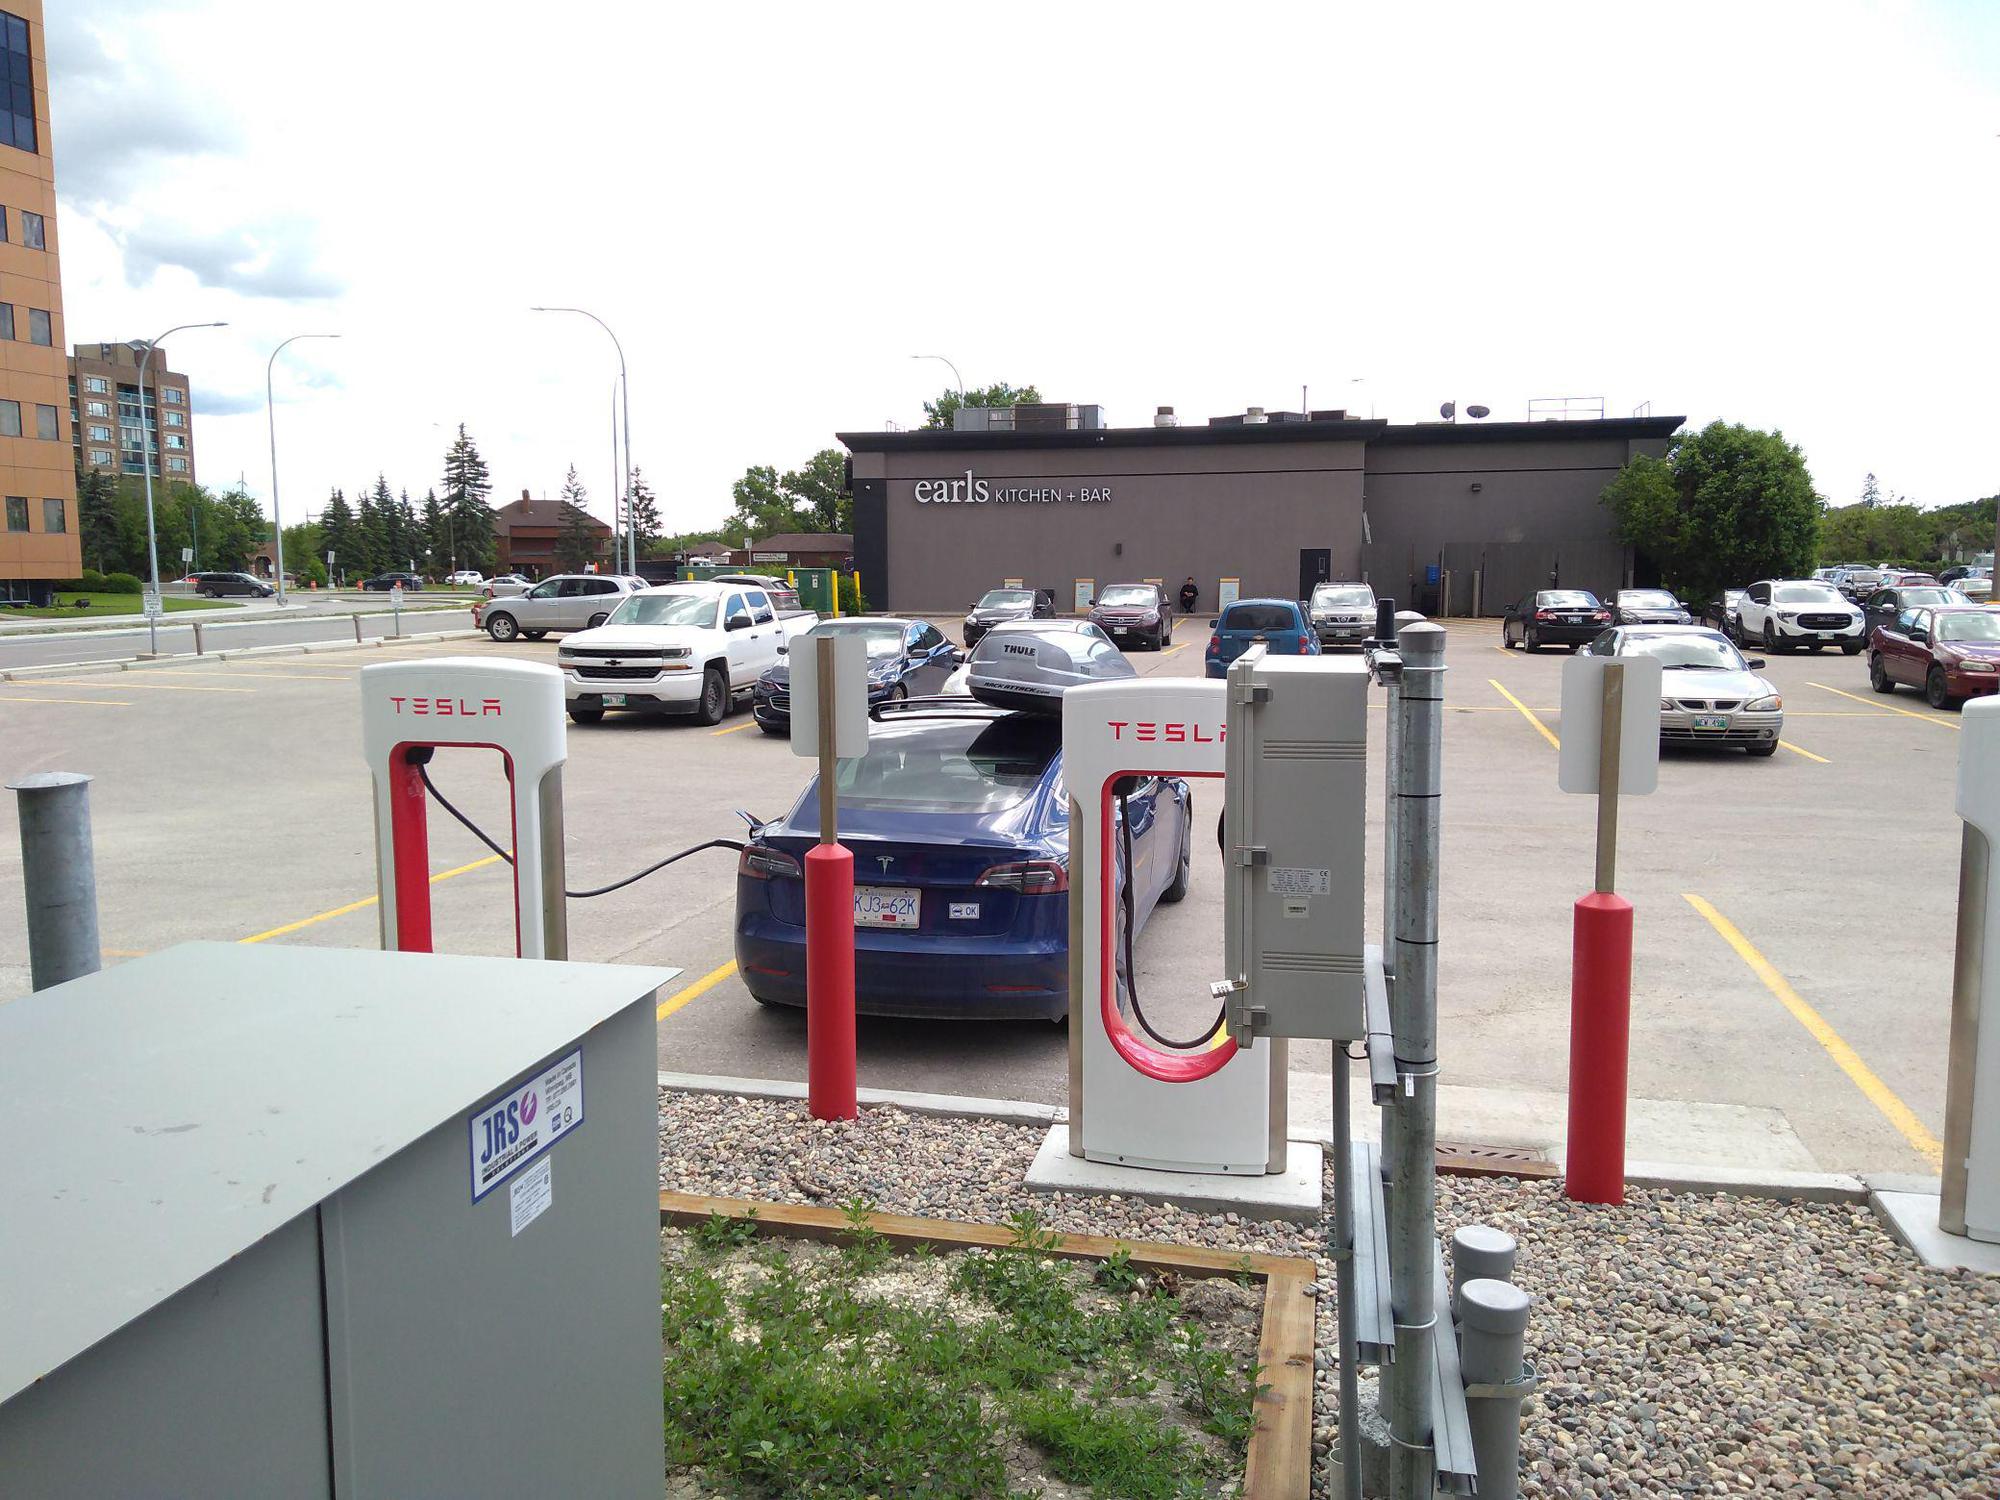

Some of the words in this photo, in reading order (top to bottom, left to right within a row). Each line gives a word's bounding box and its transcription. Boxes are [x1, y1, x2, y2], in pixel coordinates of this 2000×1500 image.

[914, 469, 990, 503] earls
[995, 489, 1062, 502] KITCHEN
[1081, 488, 1111, 502] BAR
[1004, 644, 1036, 656] THULE
[390, 697, 502, 716] TESLA
[481, 1100, 519, 1164] JRS
